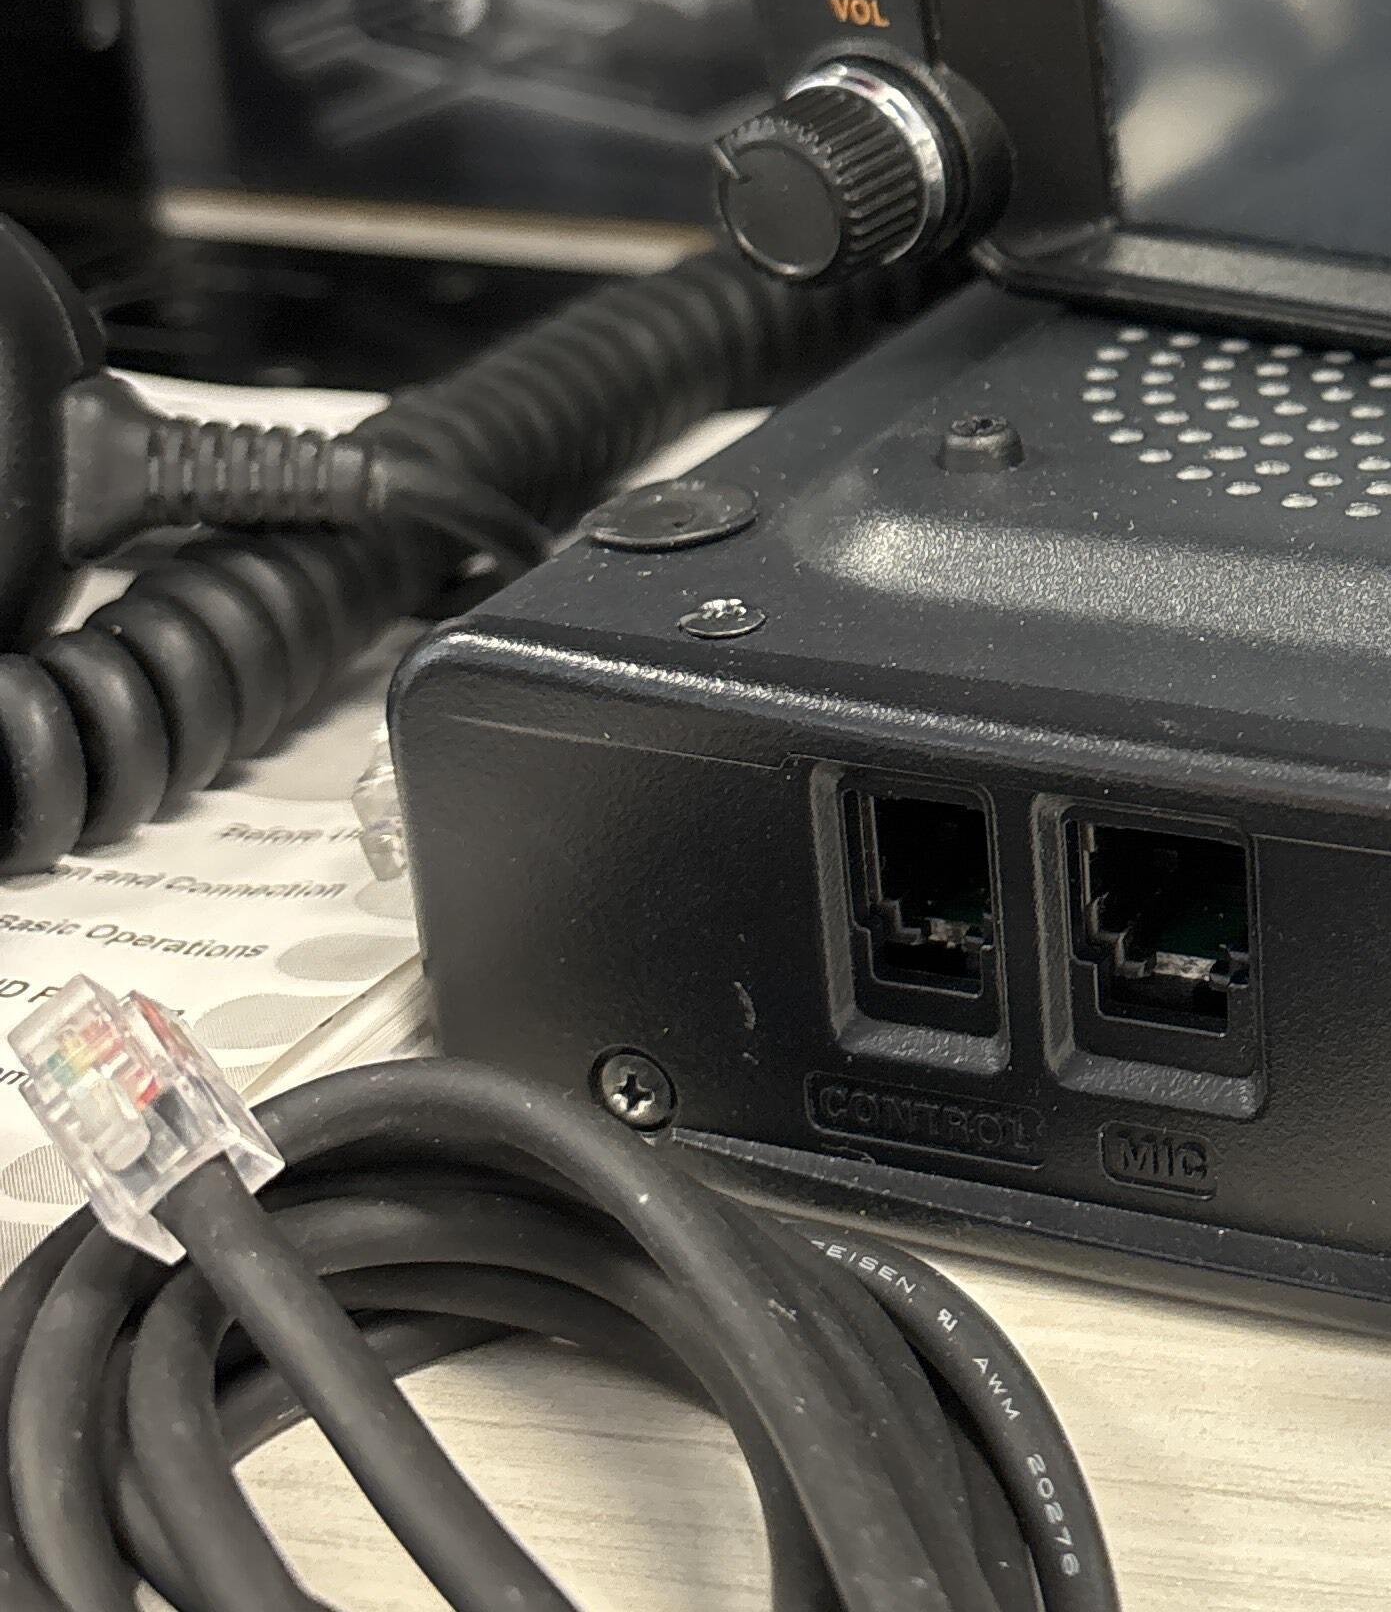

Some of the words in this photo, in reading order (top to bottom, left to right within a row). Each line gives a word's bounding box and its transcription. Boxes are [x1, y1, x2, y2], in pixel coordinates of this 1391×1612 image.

[166, 875, 348, 901] Connection
[86, 923, 270, 960] Operations
[819, 1084, 1033, 1151] CONTROL
[1116, 1128, 1208, 1181] MIC
[971, 1356, 1021, 1422] AWM
